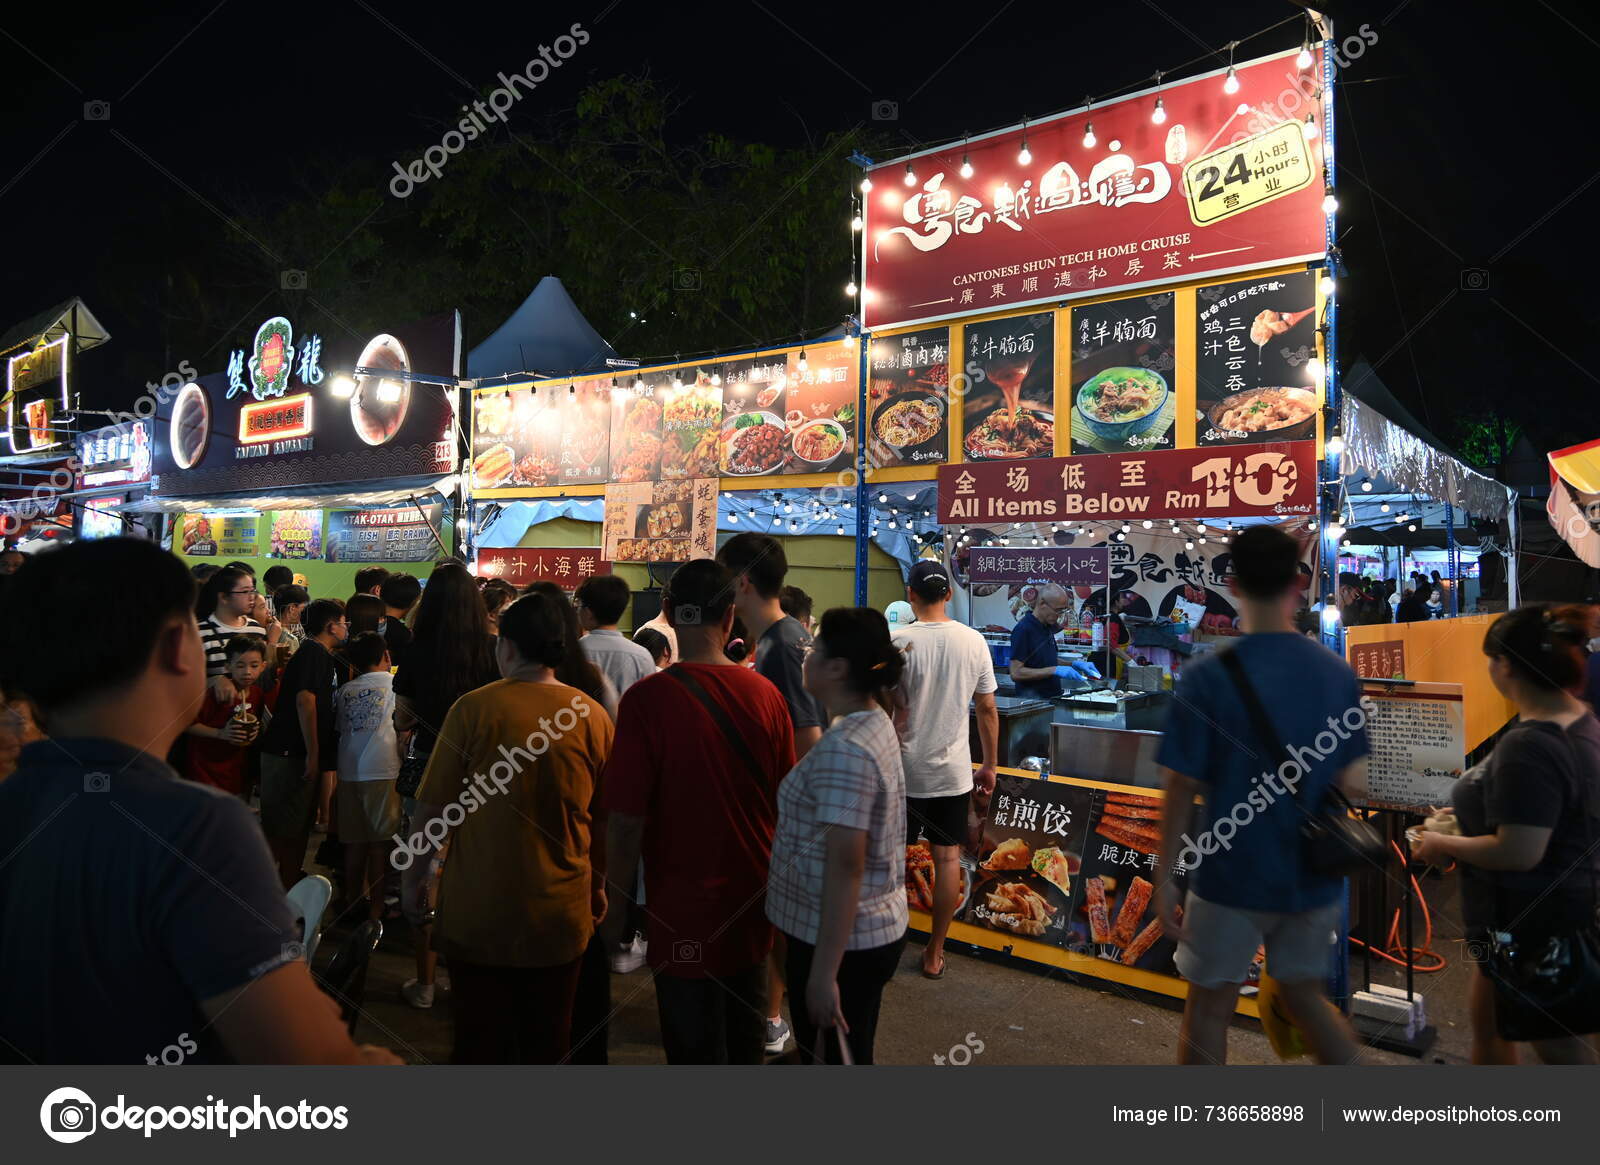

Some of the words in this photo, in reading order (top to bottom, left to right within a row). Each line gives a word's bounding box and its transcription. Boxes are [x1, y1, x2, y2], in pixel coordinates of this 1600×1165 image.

[1195, 153, 1253, 203] 24
[1254, 140, 1289, 164] 小时
[1254, 156, 1300, 179] Hours
[953, 264, 1021, 286] CANTONESE
[1022, 258, 1057, 274] SHUN
[1059, 251, 1095, 267] TECH
[1097, 243, 1138, 261] HOME
[1141, 232, 1192, 252] CRUISE
[959, 250, 1183, 304] 廣東順德私房菜
[982, 333, 1035, 360] 牛腩面
[1092, 315, 1158, 347] 羊腩面
[1203, 319, 1224, 356] 鸡汁
[1224, 317, 1247, 391] 三色云吞
[437, 444, 451, 458] 213
[949, 498, 980, 518] All
[987, 495, 1057, 517] Items
[1066, 492, 1150, 515] Below
[1165, 490, 1201, 508] Rm
[1191, 452, 1298, 507] 10
[953, 459, 1147, 495] 全场低至
[343, 512, 396, 526] OTAK-OTAK
[359, 530, 379, 542] FISH
[403, 528, 431, 541] PRAWN
[976, 555, 1103, 575] 網紅鐵板小吃
[993, 794, 1011, 827] 铁板
[1009, 797, 1073, 838] 煎饺
